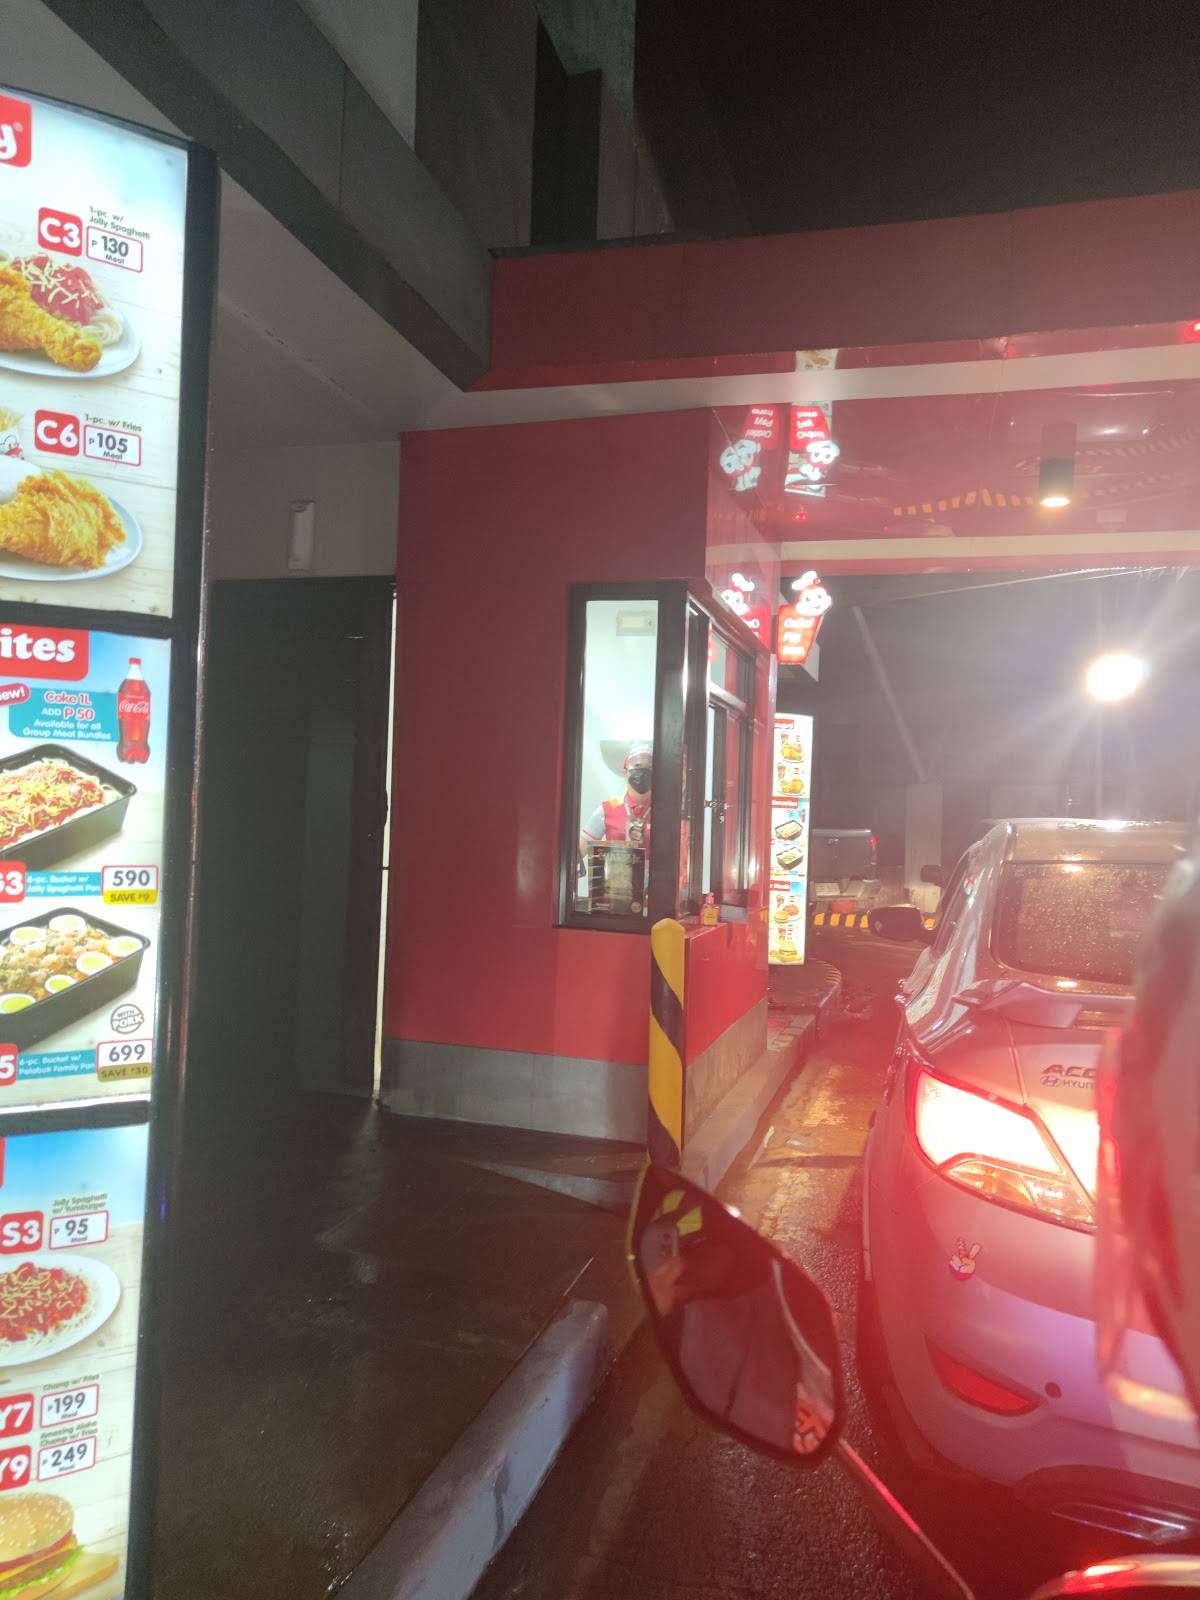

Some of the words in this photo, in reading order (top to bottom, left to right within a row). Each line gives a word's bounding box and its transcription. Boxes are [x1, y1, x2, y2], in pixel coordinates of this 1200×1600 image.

[40, 217, 81, 248] C3
[110, 221, 150, 240] Spaghetti
[101, 235, 129, 257] 130
[105, 254, 125, 265] Meal
[37, 419, 78, 448] C6
[97, 433, 128, 453] 105
[103, 451, 123, 460] Meal
[0, 628, 75, 662] ites
[45, 691, 77, 704] Coke
[42, 707, 61, 716] ADD
[76, 708, 95, 719] 50
[34, 720, 74, 729] Available
[76, 721, 89, 729] for
[91, 721, 101, 730] all
[23, 728, 51, 738] Group
[53, 729, 75, 738] Meal
[77, 730, 111, 740] Bundles
[112, 870, 150, 887] 590
[110, 894, 136, 903] SAVE
[117, 1009, 136, 1018] WITH
[112, 1015, 144, 1030] PORK
[42, 1054, 69, 1065] Bucket
[109, 1044, 146, 1062] 699
[101, 1069, 126, 1078] SAVE
[2, 1219, 40, 1247] S3
[65, 1218, 89, 1237] 95
[54, 1392, 86, 1414] 199
[51, 1443, 87, 1467] 249
